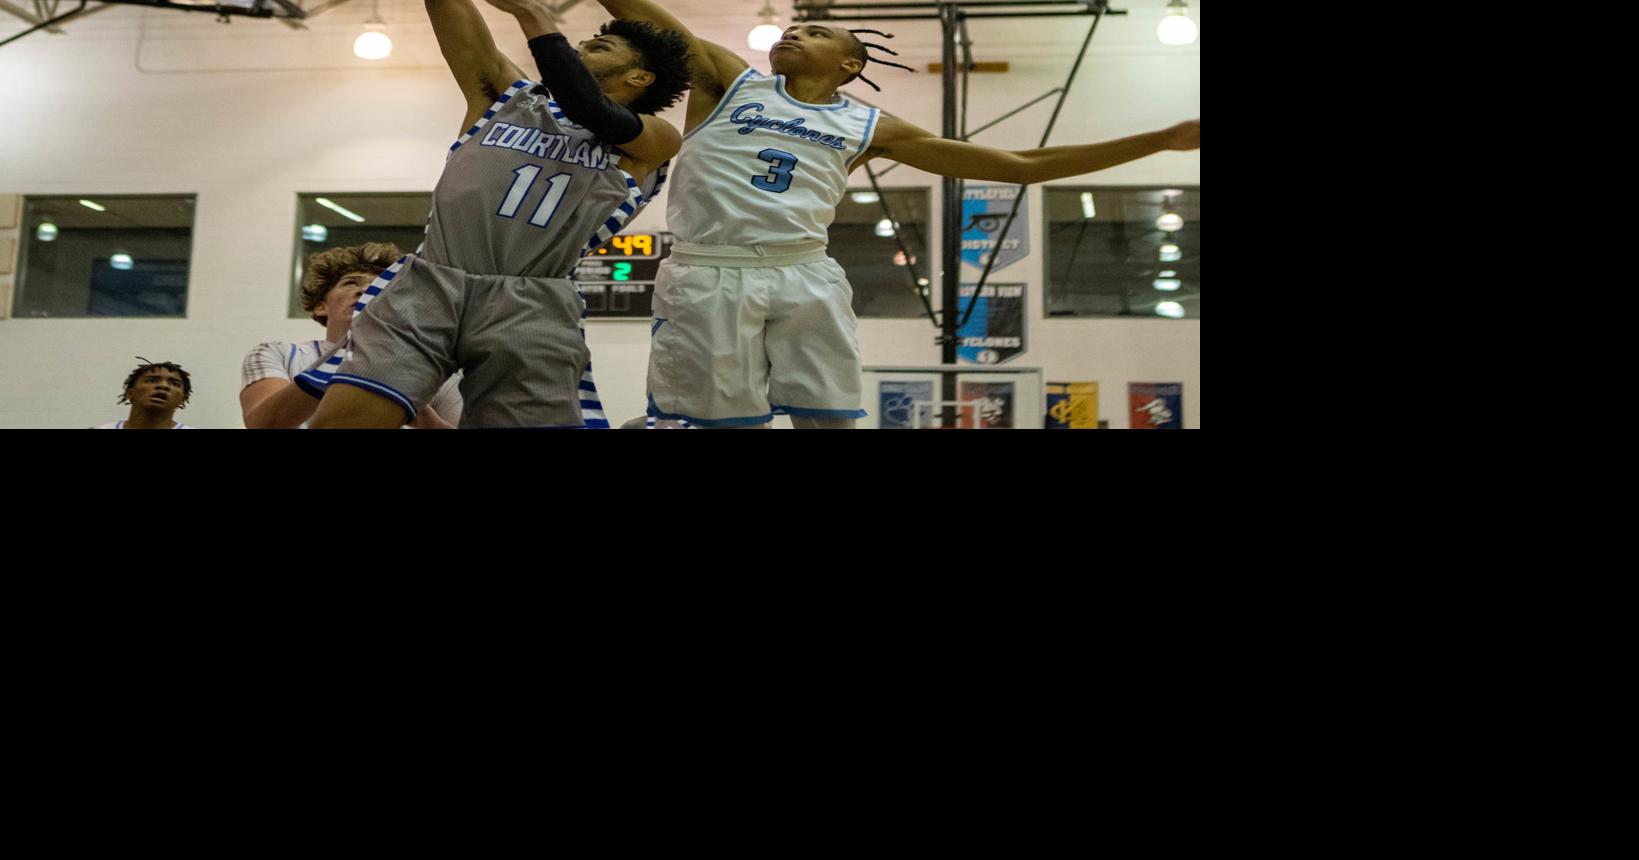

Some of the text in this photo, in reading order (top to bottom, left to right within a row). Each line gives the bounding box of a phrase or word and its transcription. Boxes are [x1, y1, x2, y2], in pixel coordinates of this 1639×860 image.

[729, 102, 848, 150] Cyclones
[750, 148, 799, 194] 3
[496, 163, 573, 229] 11
[613, 262, 632, 281] 2
